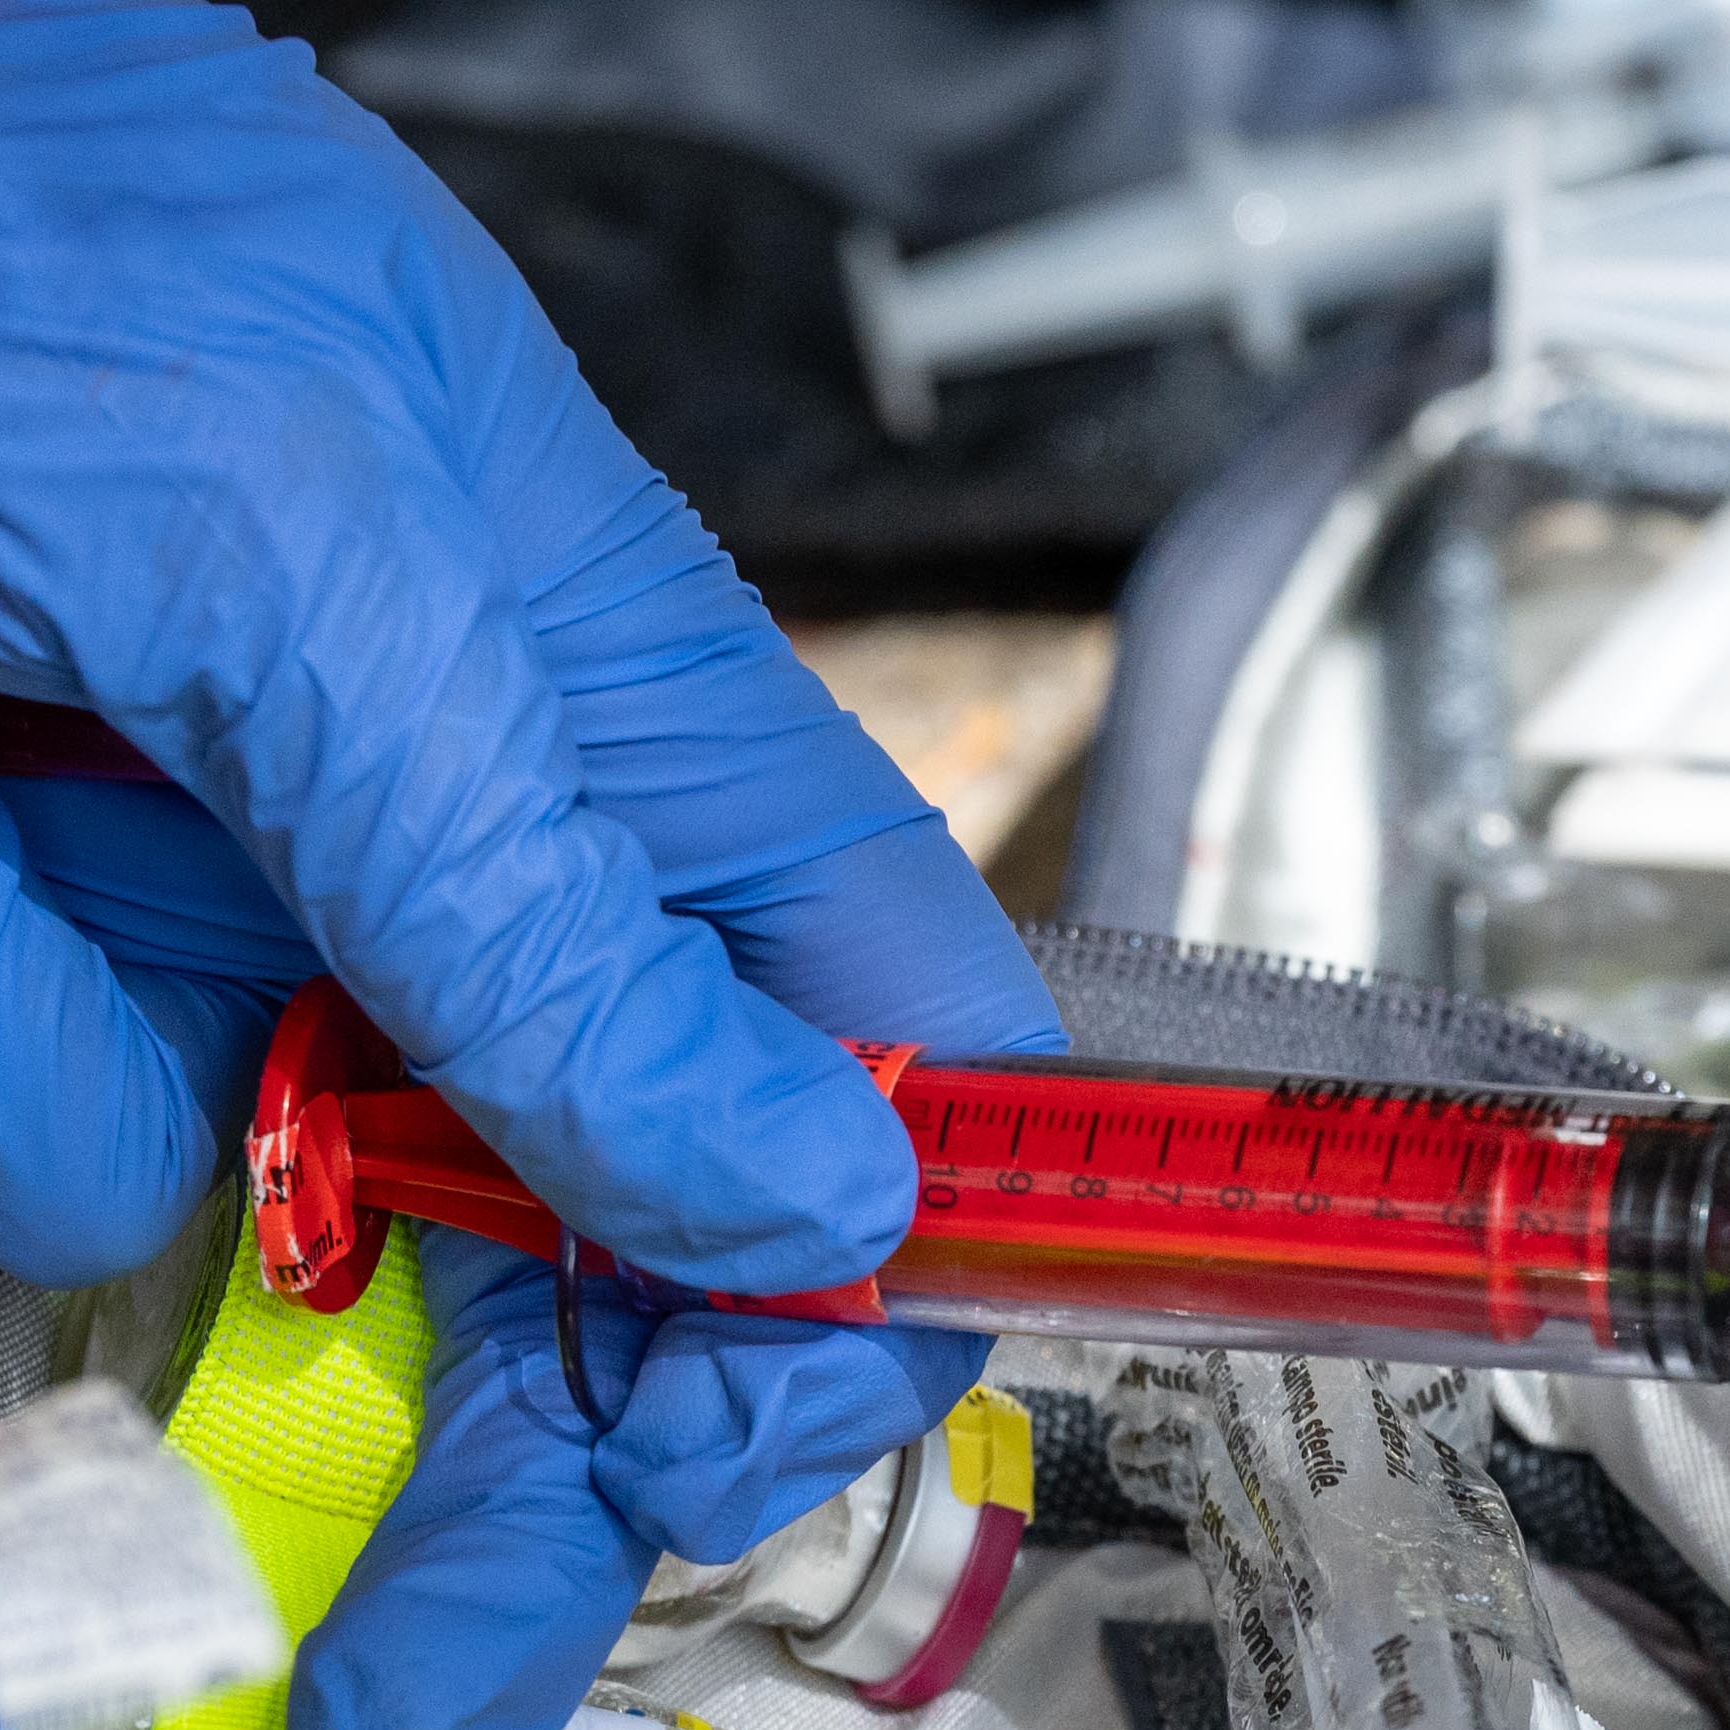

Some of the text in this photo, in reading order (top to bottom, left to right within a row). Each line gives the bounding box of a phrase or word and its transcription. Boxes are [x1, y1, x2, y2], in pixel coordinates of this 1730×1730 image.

[923, 1164, 959, 1209] 10
[996, 1169, 1034, 1195] 9
[1070, 1175, 1109, 1201] 8
[1145, 1183, 1183, 1206] 7
[1217, 1186, 1256, 1210] 6
[1292, 1191, 1331, 1216] 5
